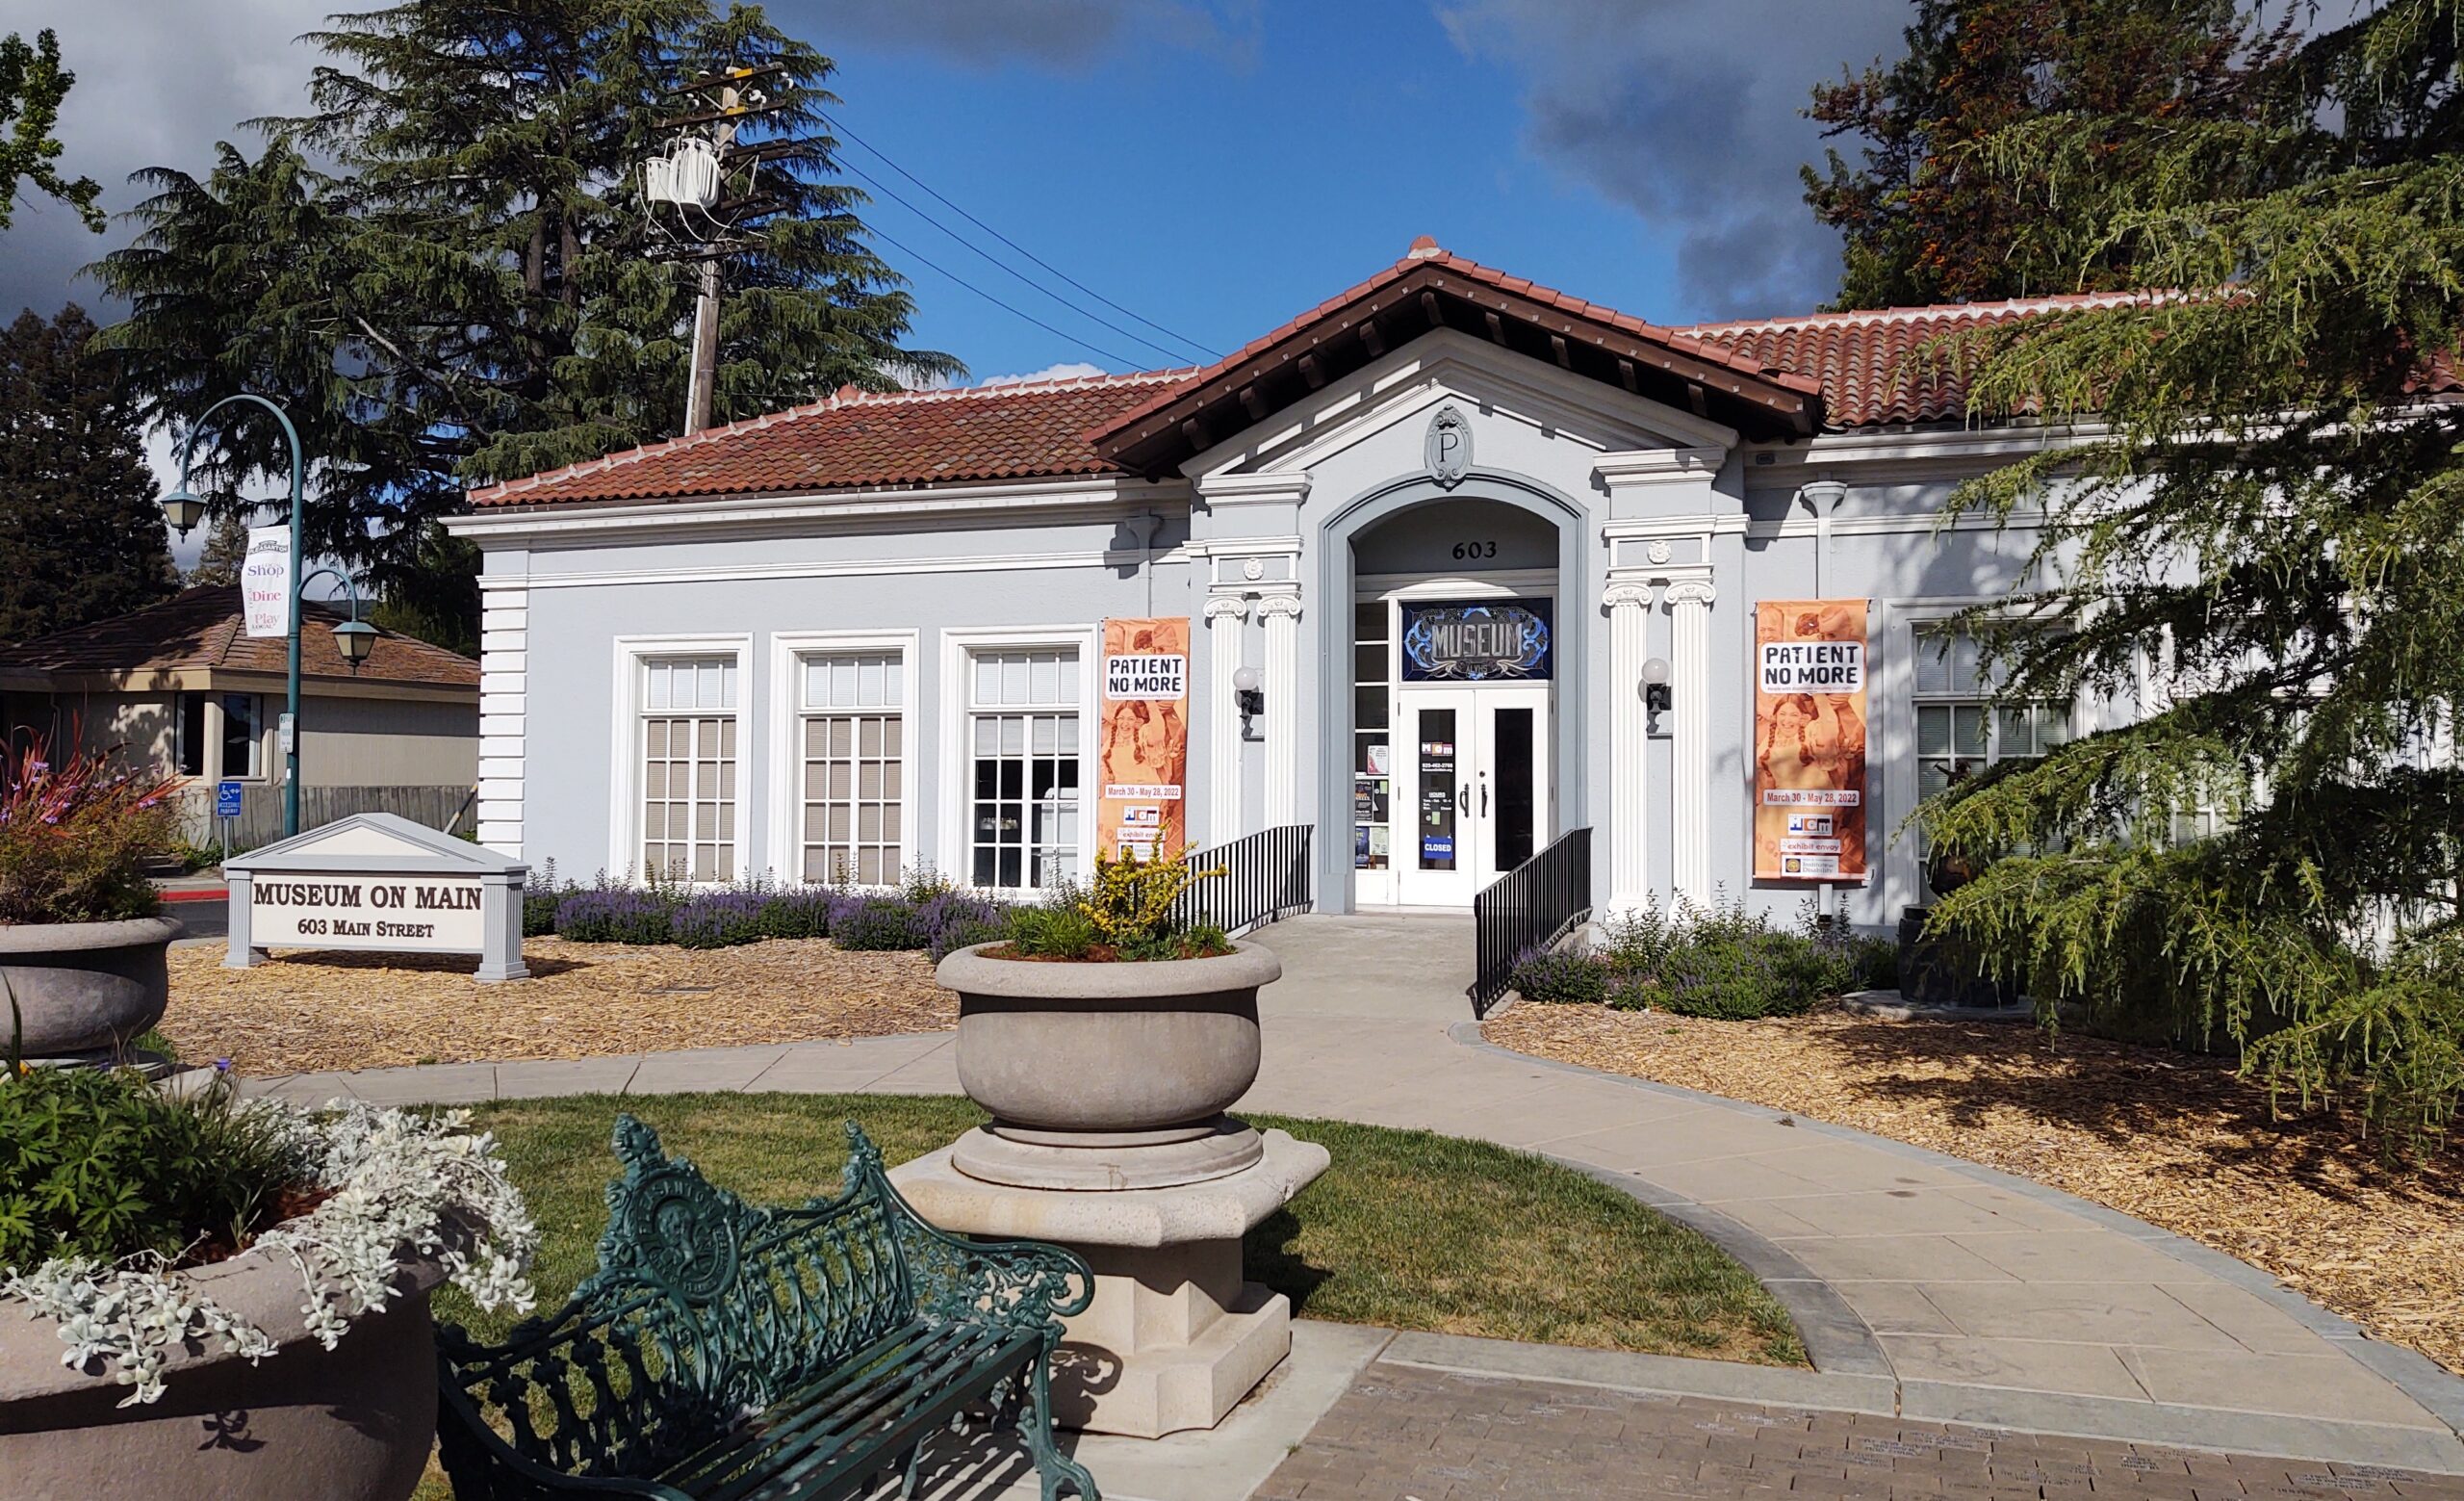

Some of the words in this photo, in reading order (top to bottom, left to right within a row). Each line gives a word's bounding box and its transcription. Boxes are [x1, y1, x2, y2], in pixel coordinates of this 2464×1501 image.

[1439, 432, 1458, 463] P
[1451, 541, 1498, 560] 603
[247, 564, 284, 578] Shop
[252, 590, 281, 602] Dine
[254, 613, 280, 626] Play
[1431, 623, 1523, 658] MUSEUM
[1765, 646, 1859, 664] PATIENT
[1110, 659, 1182, 675] PATIENT
[1765, 667, 1791, 685] NO
[1798, 666, 1858, 685] MORE
[1109, 677, 1129, 692] NO
[1134, 677, 1182, 692] MORE
[1108, 788, 1126, 796] March
[1127, 788, 1135, 796] 30
[1140, 788, 1152, 798] May
[1153, 788, 1163, 797] 28,
[1164, 788, 1179, 796] 2022
[1767, 792, 1790, 802] March
[1791, 792, 1801, 802] 30
[1808, 793, 1822, 805] May
[1824, 793, 1836, 804] 28,
[1838, 793, 1857, 803] 2022
[1424, 843, 1451, 852] CLOSED
[253, 882, 362, 908] MUSEUM
[370, 885, 406, 909] ON
[414, 886, 483, 911] MAIN
[297, 918, 327, 935] 603
[332, 919, 372, 937] MAIN
[376, 919, 435, 939] STREET
